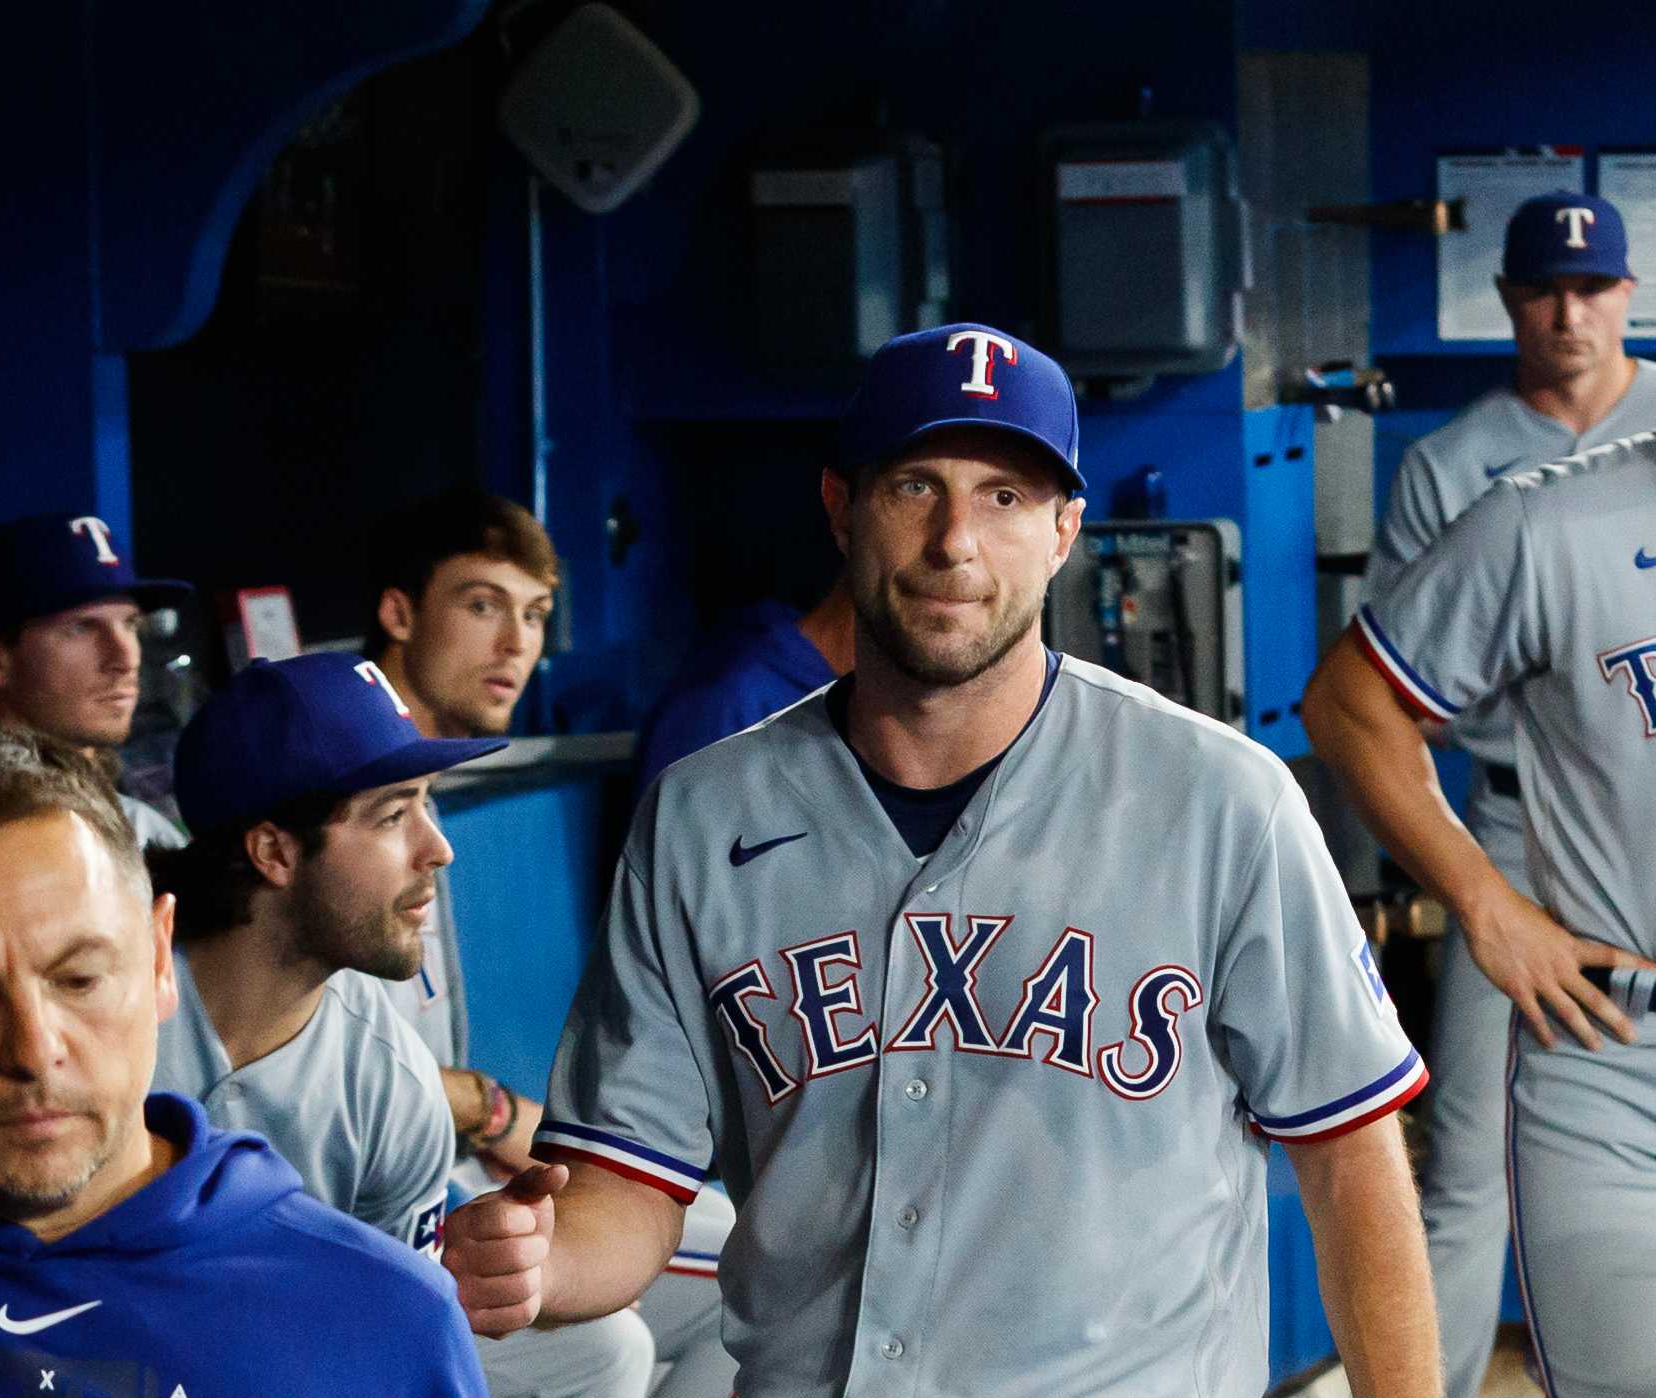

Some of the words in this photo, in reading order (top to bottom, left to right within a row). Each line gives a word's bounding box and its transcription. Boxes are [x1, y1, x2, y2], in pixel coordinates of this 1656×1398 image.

[1556, 207, 1595, 249] T
[946, 330, 1019, 401] T
[68, 515, 120, 567] T
[354, 660, 411, 718] T
[709, 911, 1204, 1107] TEXAS
